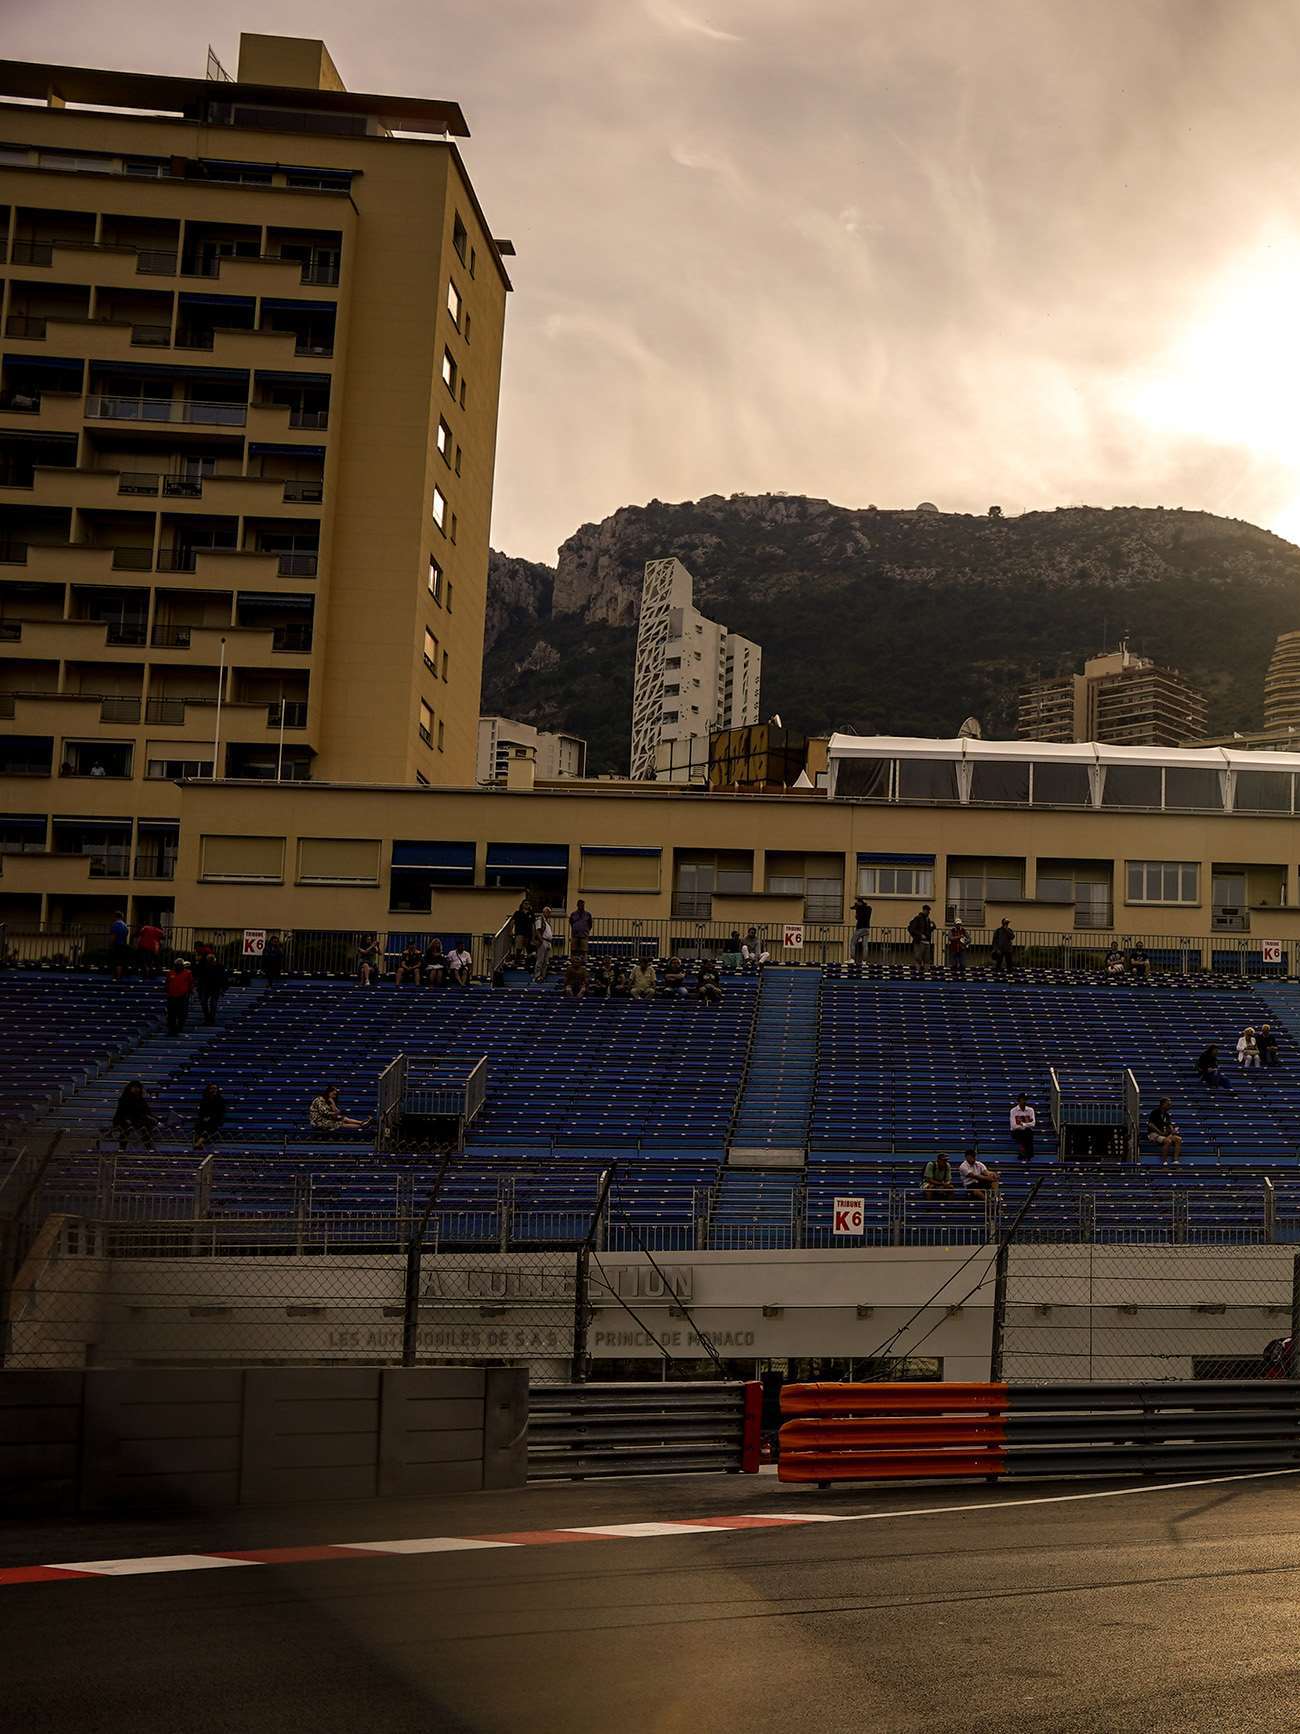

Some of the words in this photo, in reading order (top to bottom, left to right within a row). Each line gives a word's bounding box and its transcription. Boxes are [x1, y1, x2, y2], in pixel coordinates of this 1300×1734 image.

[244, 938, 264, 953] K6
[785, 933, 802, 946] K6
[1264, 948, 1280, 961] K6
[836, 1200, 862, 1208] TRIBUNE
[835, 1211, 862, 1231] K6
[367, 1331, 481, 1347] AUTOOBILES
[595, 1331, 653, 1347] PRINCE
[662, 1331, 681, 1347] DE
